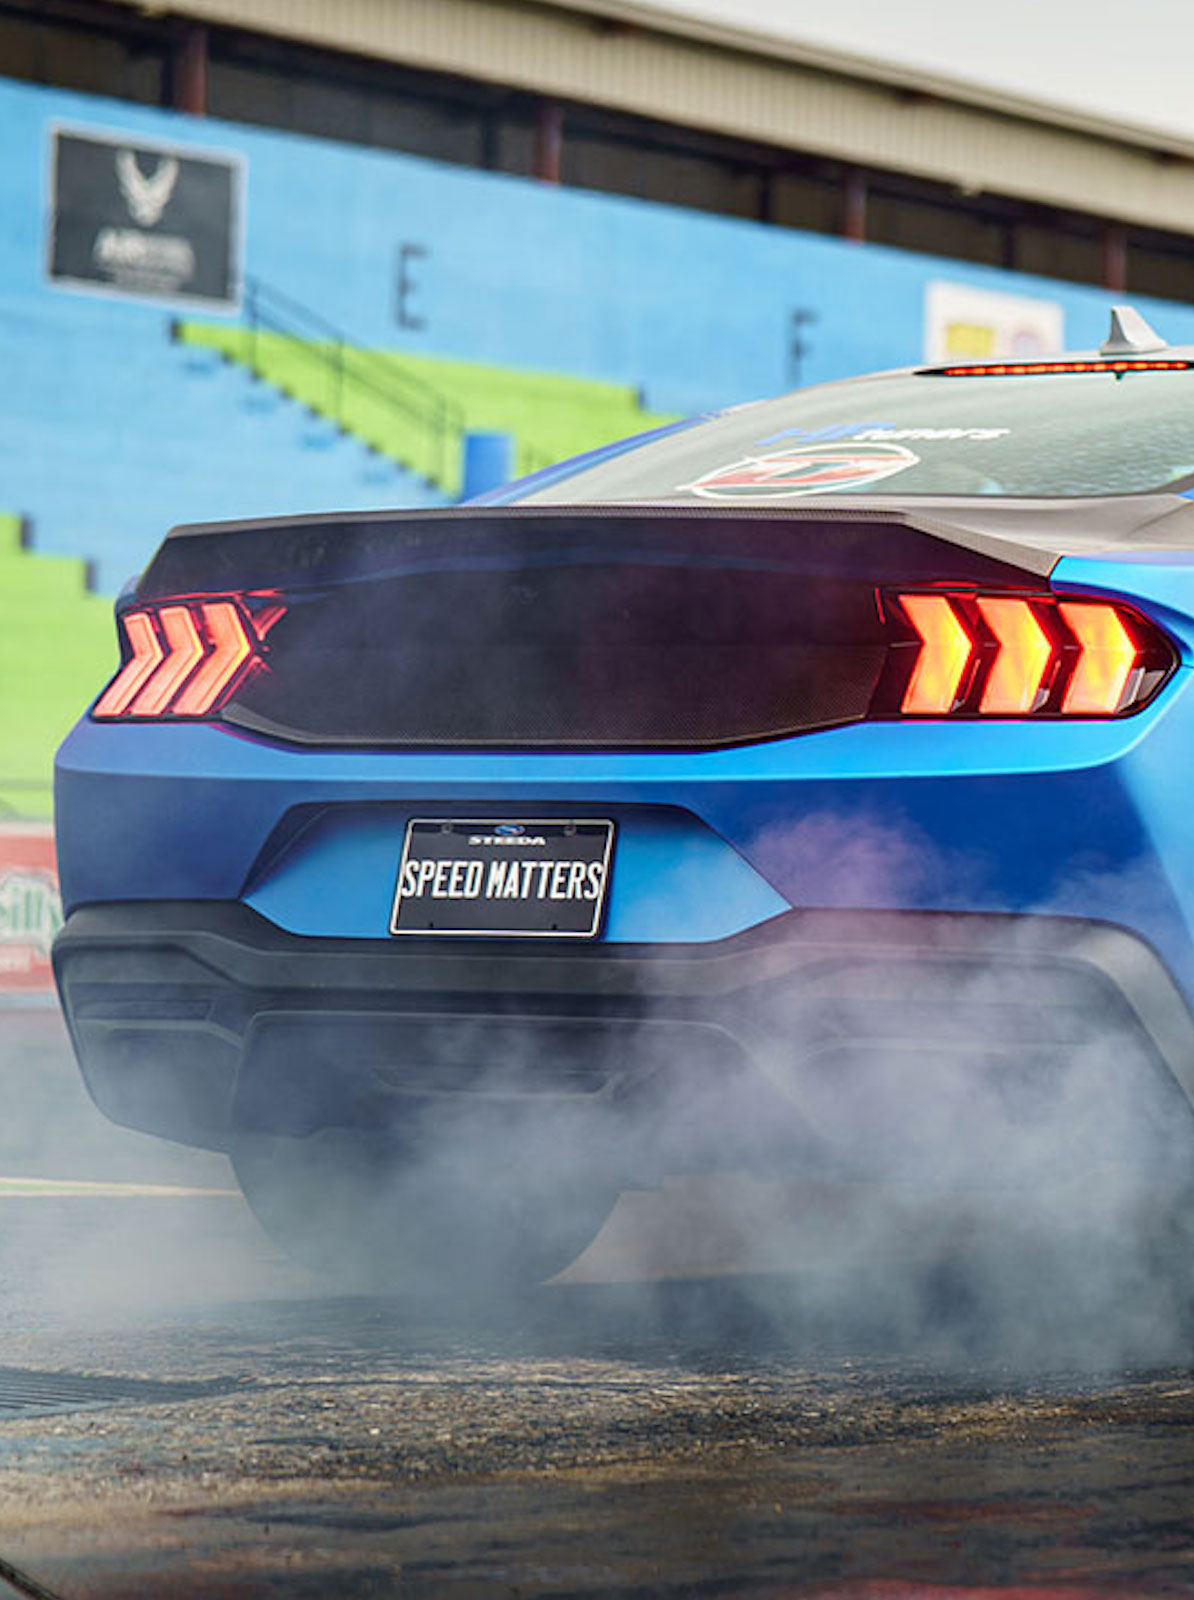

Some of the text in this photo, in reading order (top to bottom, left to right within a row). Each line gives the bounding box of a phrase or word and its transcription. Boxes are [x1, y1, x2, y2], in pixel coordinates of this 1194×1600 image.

[396, 242, 428, 330] E
[467, 835, 547, 846] STEEDA
[401, 860, 604, 899] SPEED MATTERS
